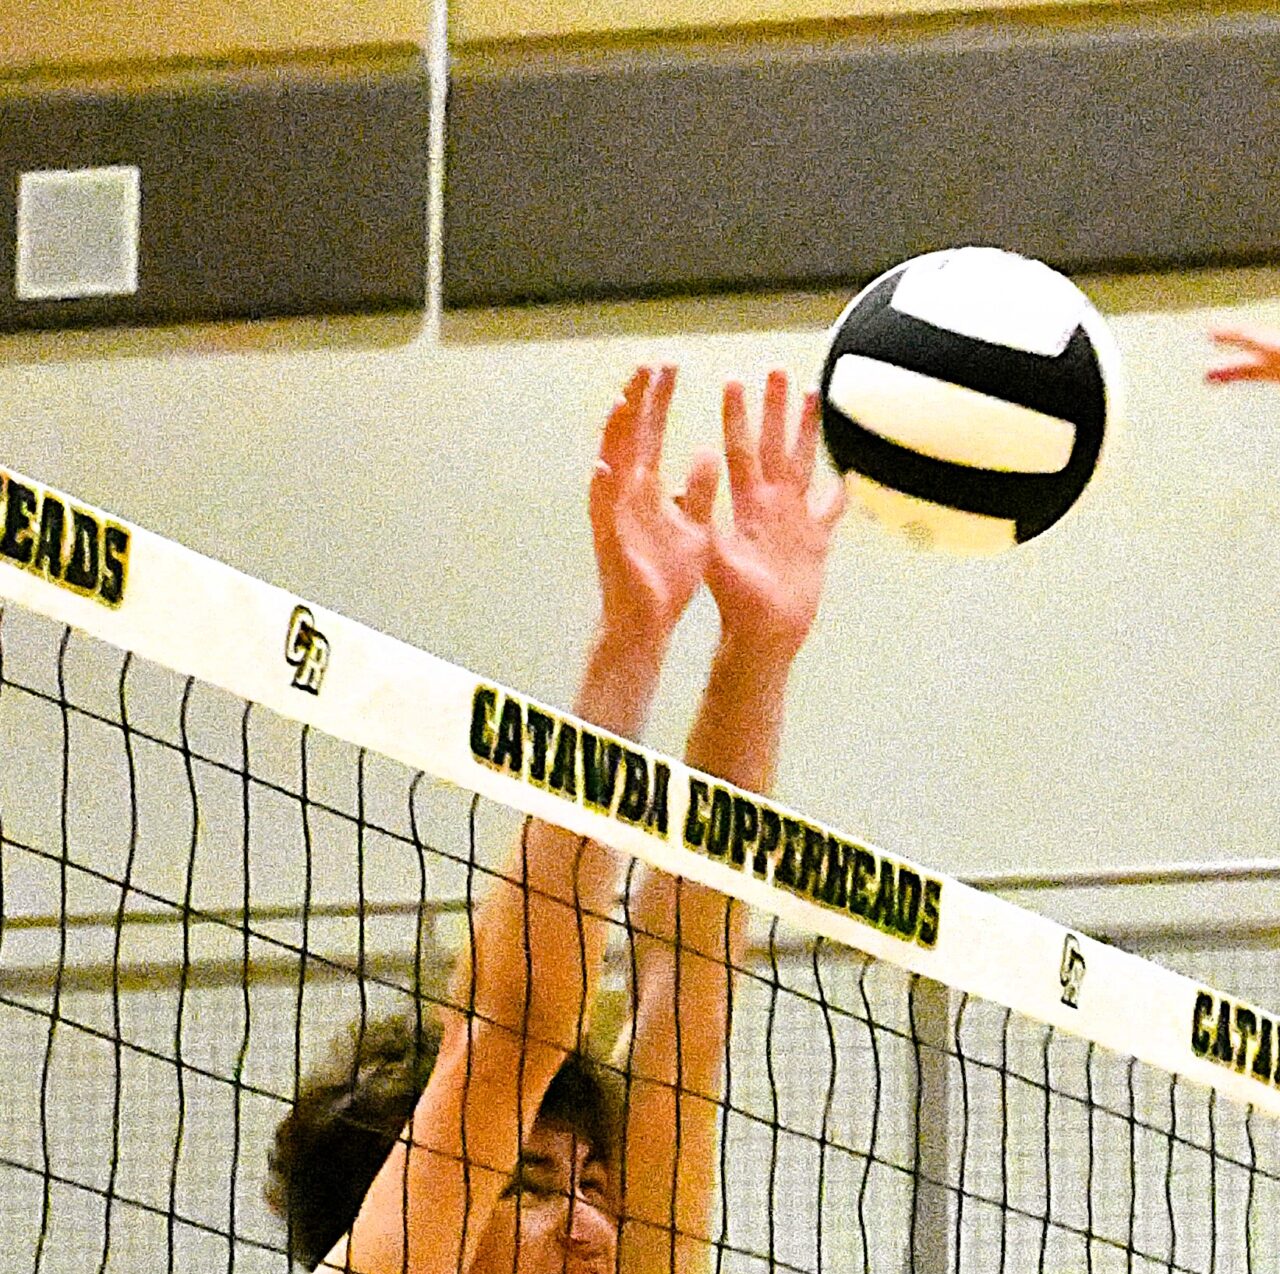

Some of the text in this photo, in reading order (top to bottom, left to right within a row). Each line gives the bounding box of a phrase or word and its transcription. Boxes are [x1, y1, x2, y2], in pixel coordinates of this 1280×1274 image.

[0, 470, 131, 610] EADS
[470, 684, 943, 949] CATAWBA COPPERHEADS
